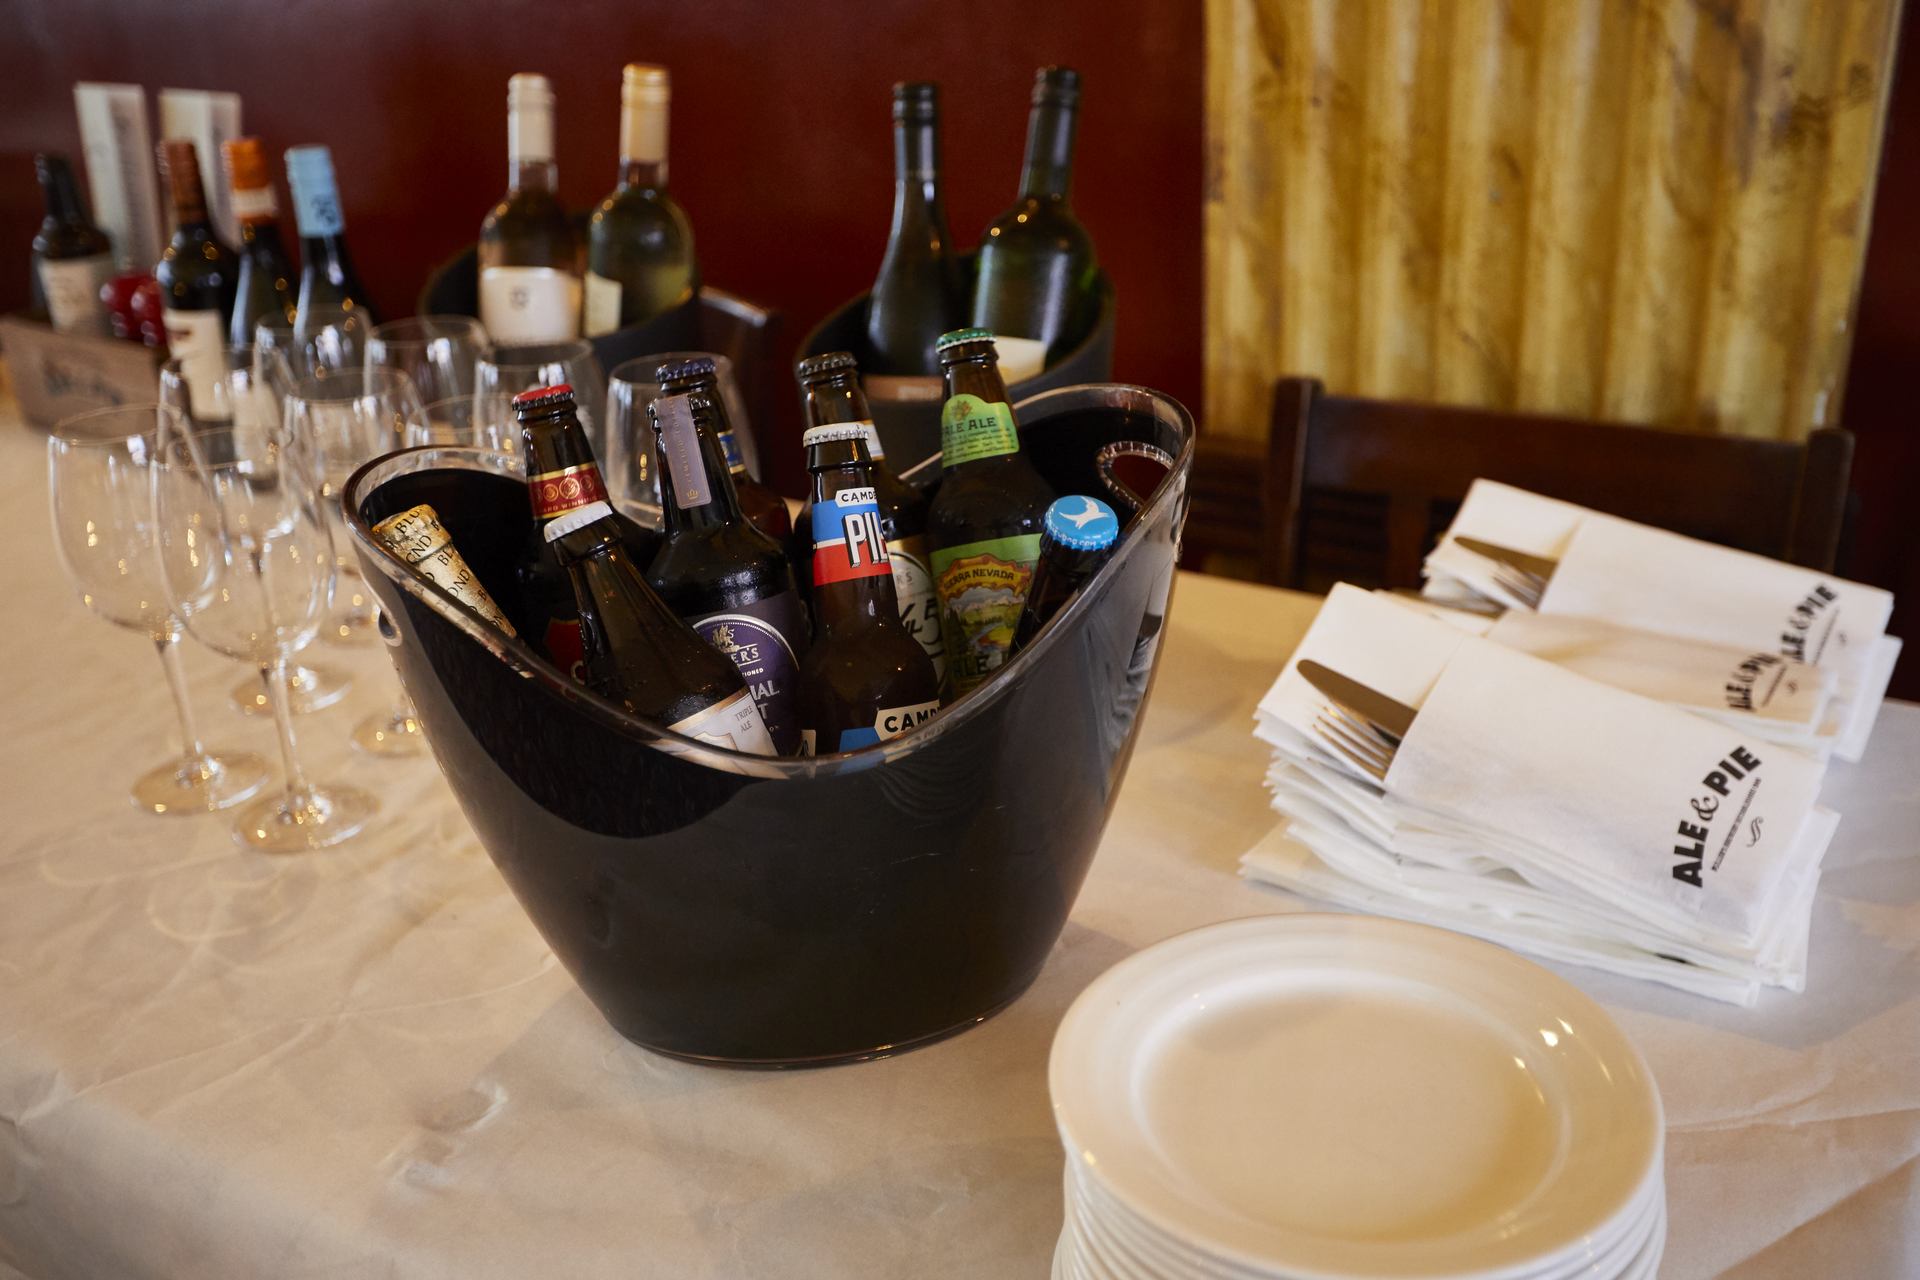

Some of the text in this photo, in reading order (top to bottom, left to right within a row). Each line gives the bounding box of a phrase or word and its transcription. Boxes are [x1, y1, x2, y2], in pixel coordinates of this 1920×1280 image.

[968, 416, 997, 431] ALE
[972, 568, 1015, 580] NEVADA
[734, 705, 754, 721] TRIPLE
[740, 721, 752, 732] ALE
[1702, 745, 1762, 797] PIE
[1690, 796, 1720, 822] &
[1672, 819, 1709, 889] ALE
